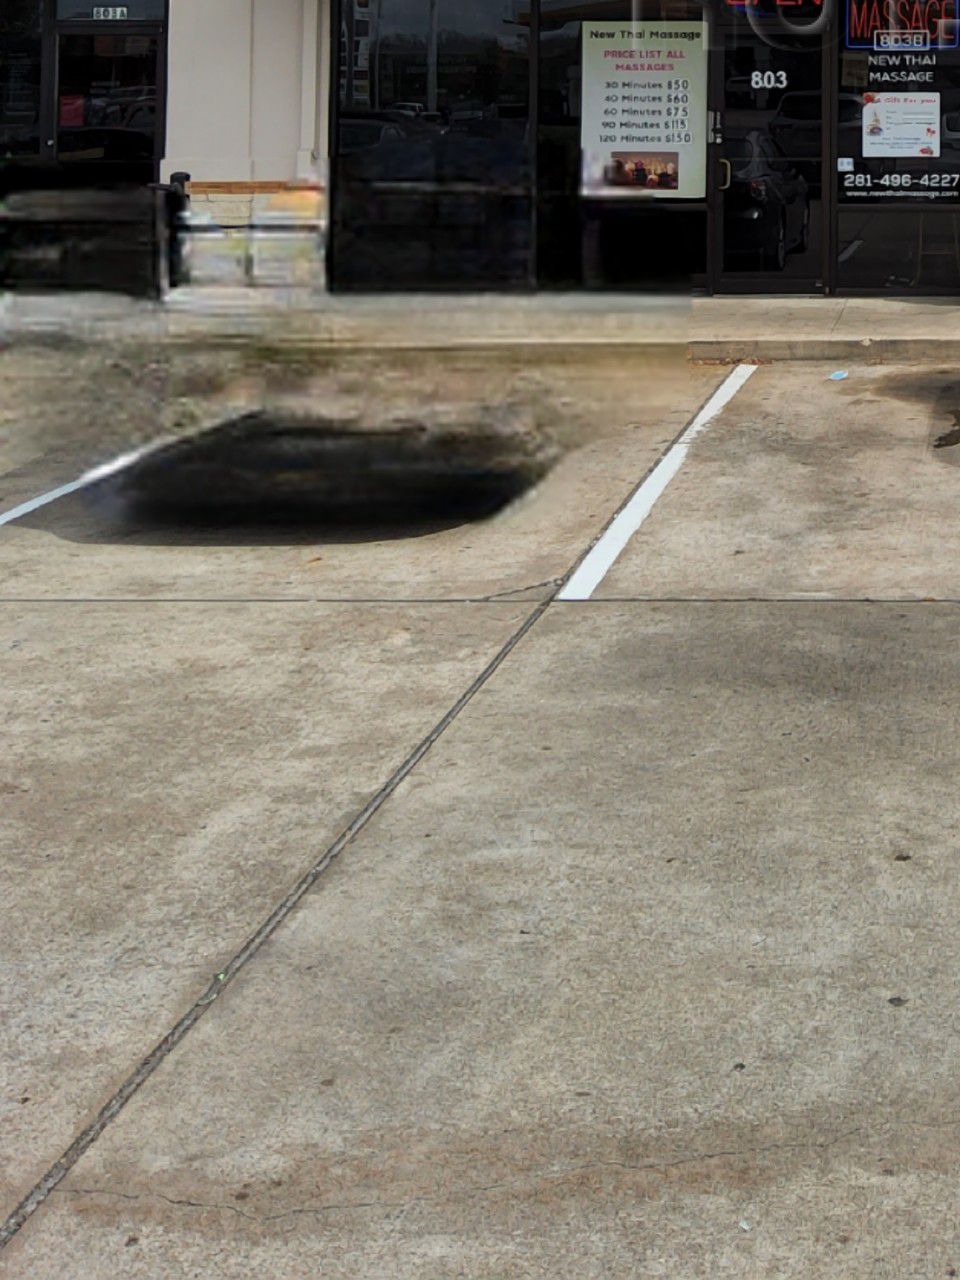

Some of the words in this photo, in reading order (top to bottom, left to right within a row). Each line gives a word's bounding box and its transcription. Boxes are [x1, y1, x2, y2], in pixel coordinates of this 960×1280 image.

[591, 30, 615, 39] New
[620, 30, 645, 39] Thai
[650, 31, 702, 41] Massage
[879, 33, 924, 47] 803B
[604, 50, 636, 59] PRICE
[640, 50, 661, 59] LIST
[666, 50, 685, 59] ALL
[868, 55, 900, 66] NEW
[903, 54, 937, 66] THAI
[615, 63, 674, 71] MASSAGES
[751, 70, 788, 89] 803
[869, 71, 935, 83] MASSAGE
[667, 79, 689, 90] $50
[667, 94, 688, 104] $60
[666, 107, 688, 117] $75
[844, 173, 960, 187] 281-496-4227
